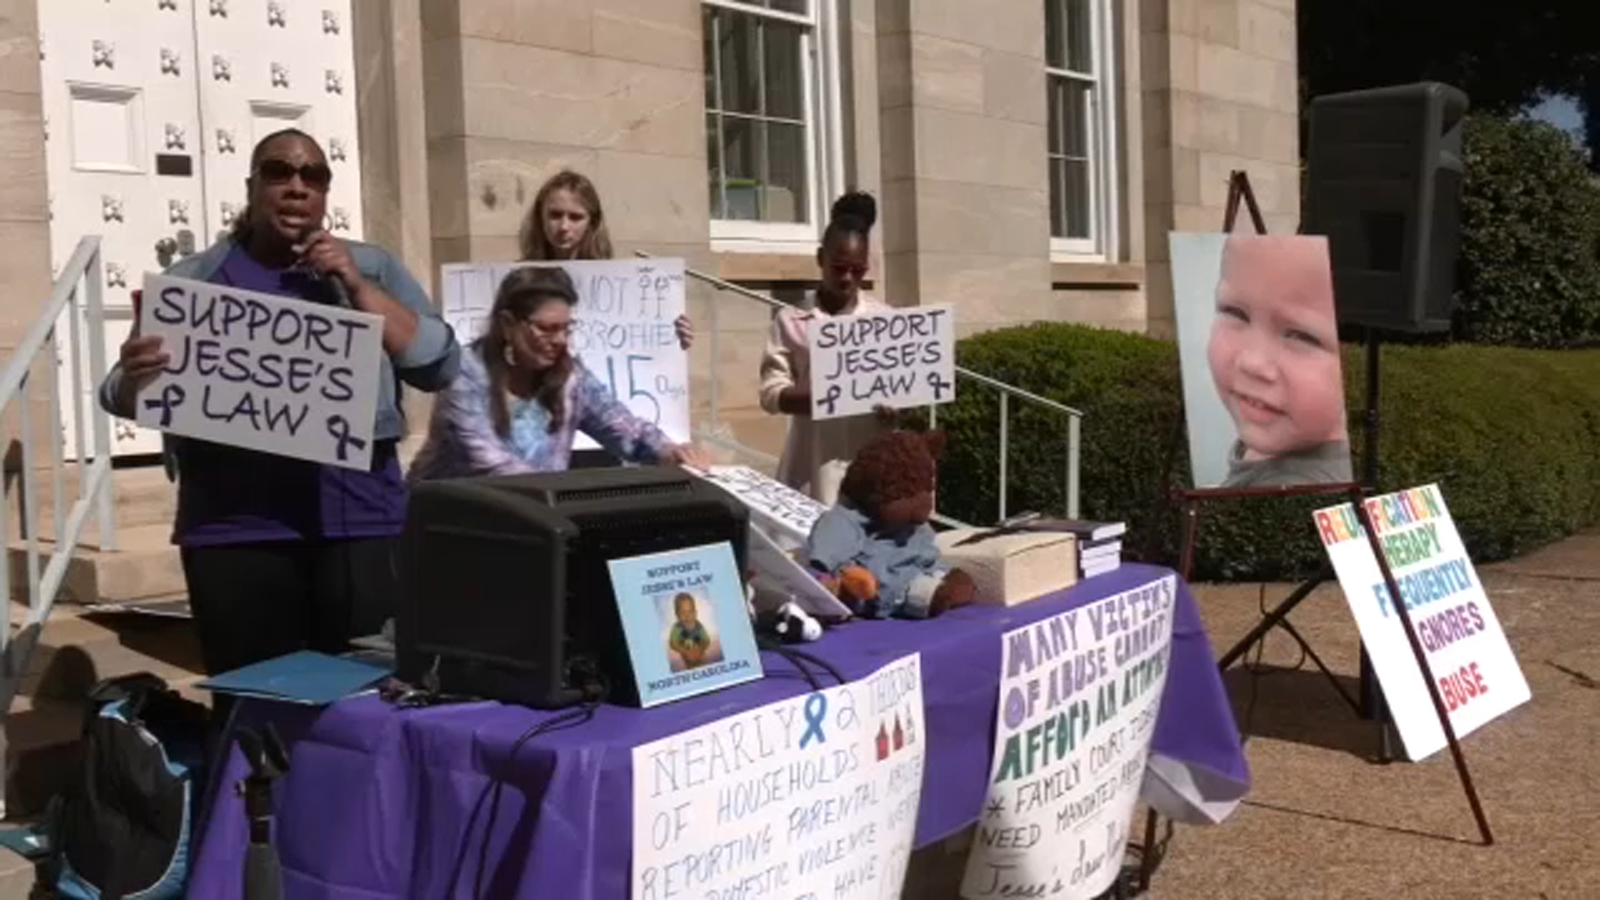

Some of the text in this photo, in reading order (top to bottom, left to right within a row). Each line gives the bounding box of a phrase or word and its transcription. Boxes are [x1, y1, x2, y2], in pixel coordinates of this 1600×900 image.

[153, 286, 370, 360] SUPPORT
[571, 318, 673, 351] BROTHE
[816, 309, 946, 349] SUPPORT
[161, 334, 354, 402] JESSE'S
[824, 341, 942, 380] JESSE'S
[851, 370, 916, 401] LAW
[201, 384, 309, 436] LAW
[1316, 486, 1442, 546] REUFICATION
[1382, 521, 1442, 571] HERAPY
[687, 571, 714, 588] LAW
[1371, 557, 1473, 619] FEQUENTLY
[1006, 579, 1171, 679] MANY VICTIMS
[1417, 600, 1486, 654] GNORES
[647, 673, 692, 693] NORTH
[1003, 678, 1040, 730] OF
[1046, 646, 1108, 711] ABUSE
[1096, 679, 1117, 726] AN
[1438, 661, 1489, 713] BUSE
[649, 706, 798, 798] NEARLY
[1014, 758, 1081, 815] FAMILY
[1089, 727, 1126, 775] COURT
[651, 741, 860, 851] OF HOUSEHOLDS
[641, 822, 773, 900] REPORTING
[788, 778, 880, 846] PARENTAL
[799, 821, 878, 876] VIOLENCE
[979, 823, 1041, 849] NEED
